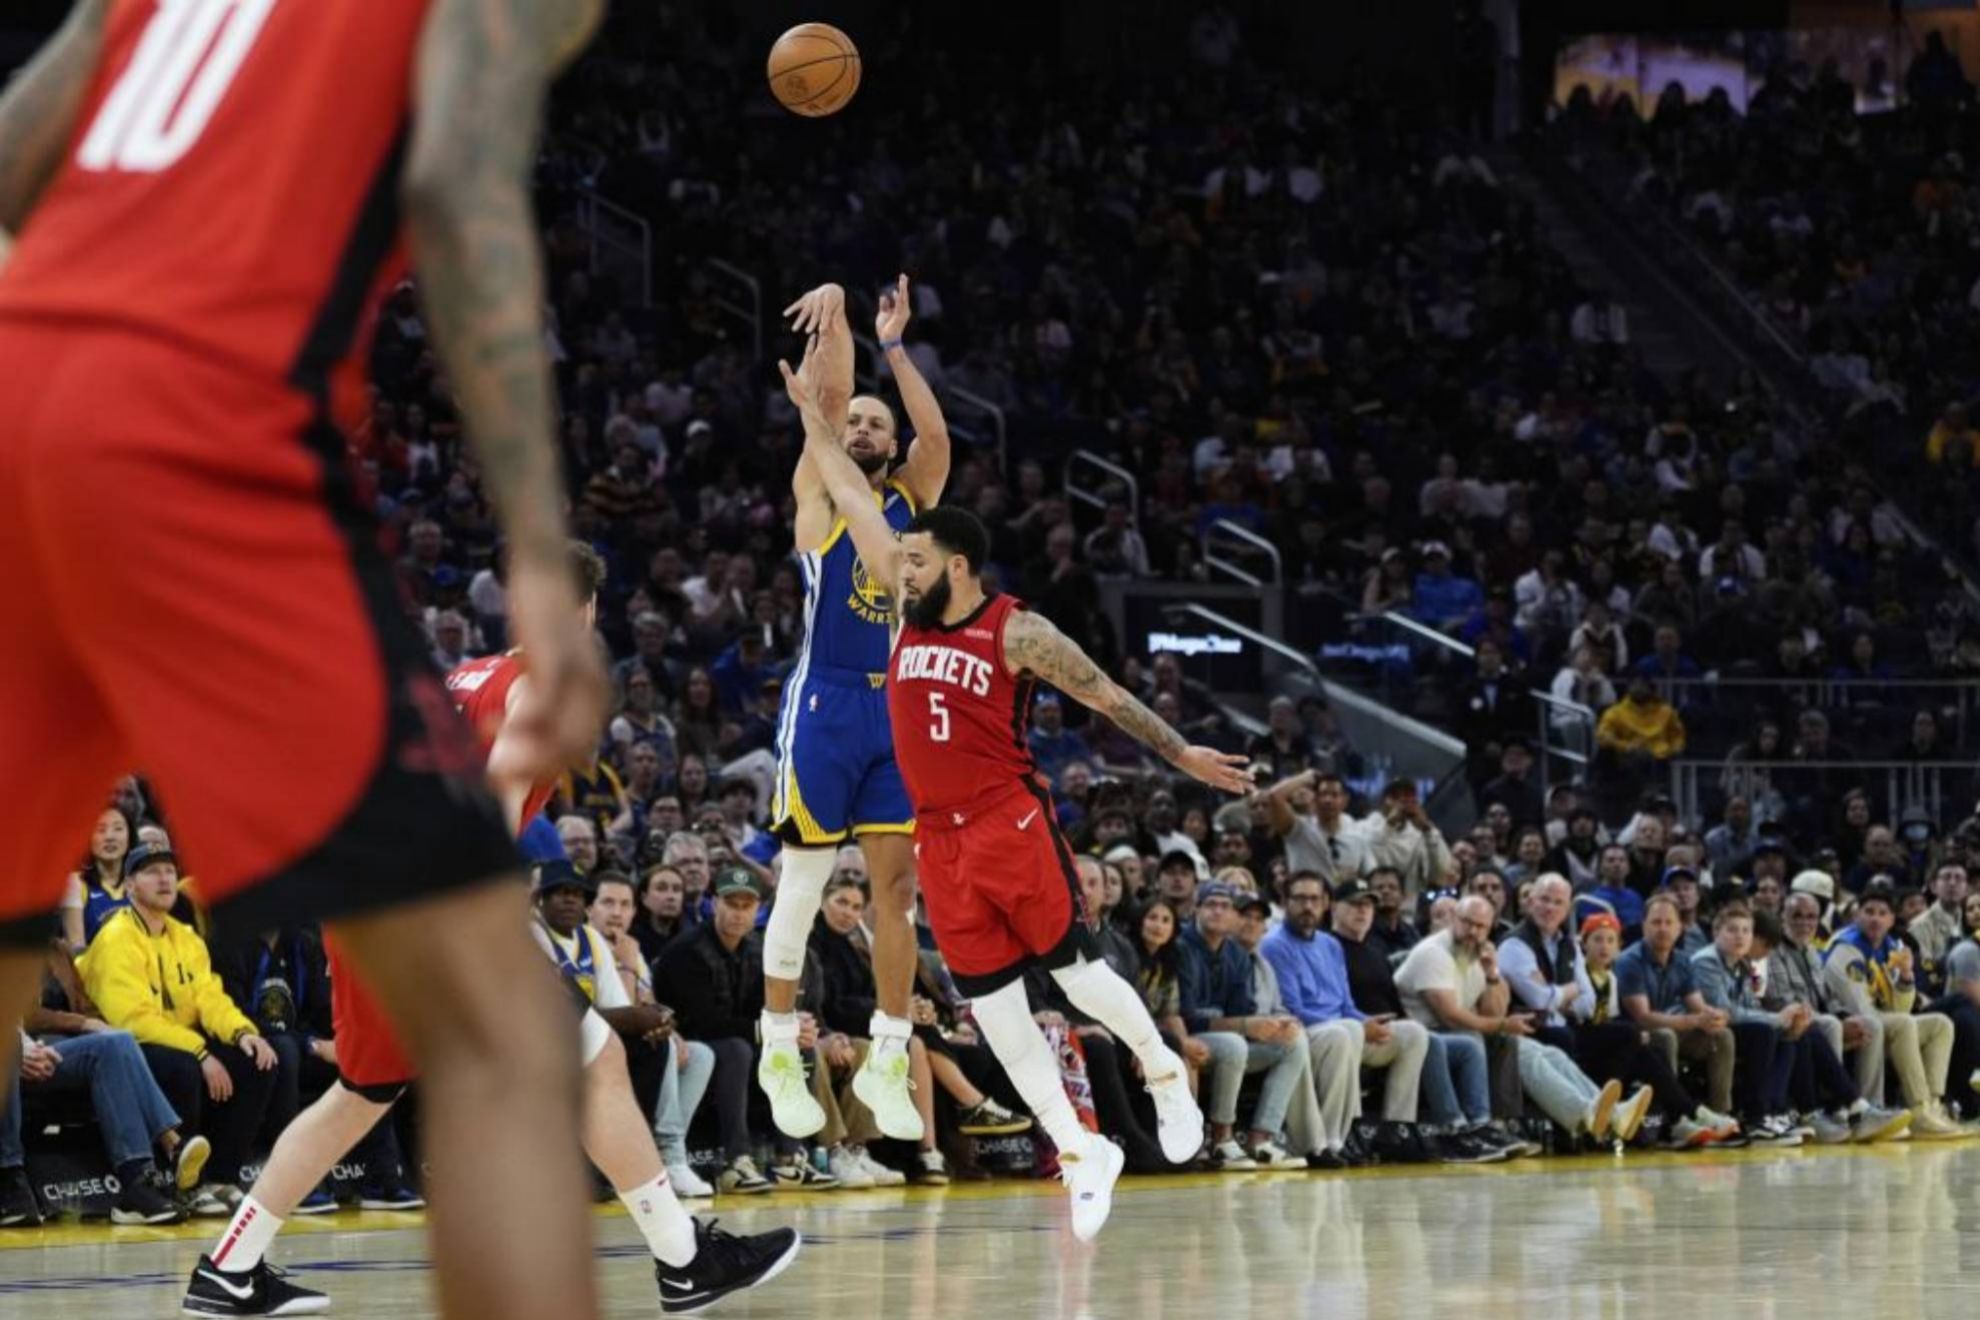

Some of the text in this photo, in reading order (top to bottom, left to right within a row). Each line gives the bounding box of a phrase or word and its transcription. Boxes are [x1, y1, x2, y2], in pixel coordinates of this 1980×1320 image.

[76, 0, 278, 171] 10
[897, 645, 993, 697] ROCKETS
[929, 692, 950, 741] 5
[331, 1164, 366, 1180] CHA
